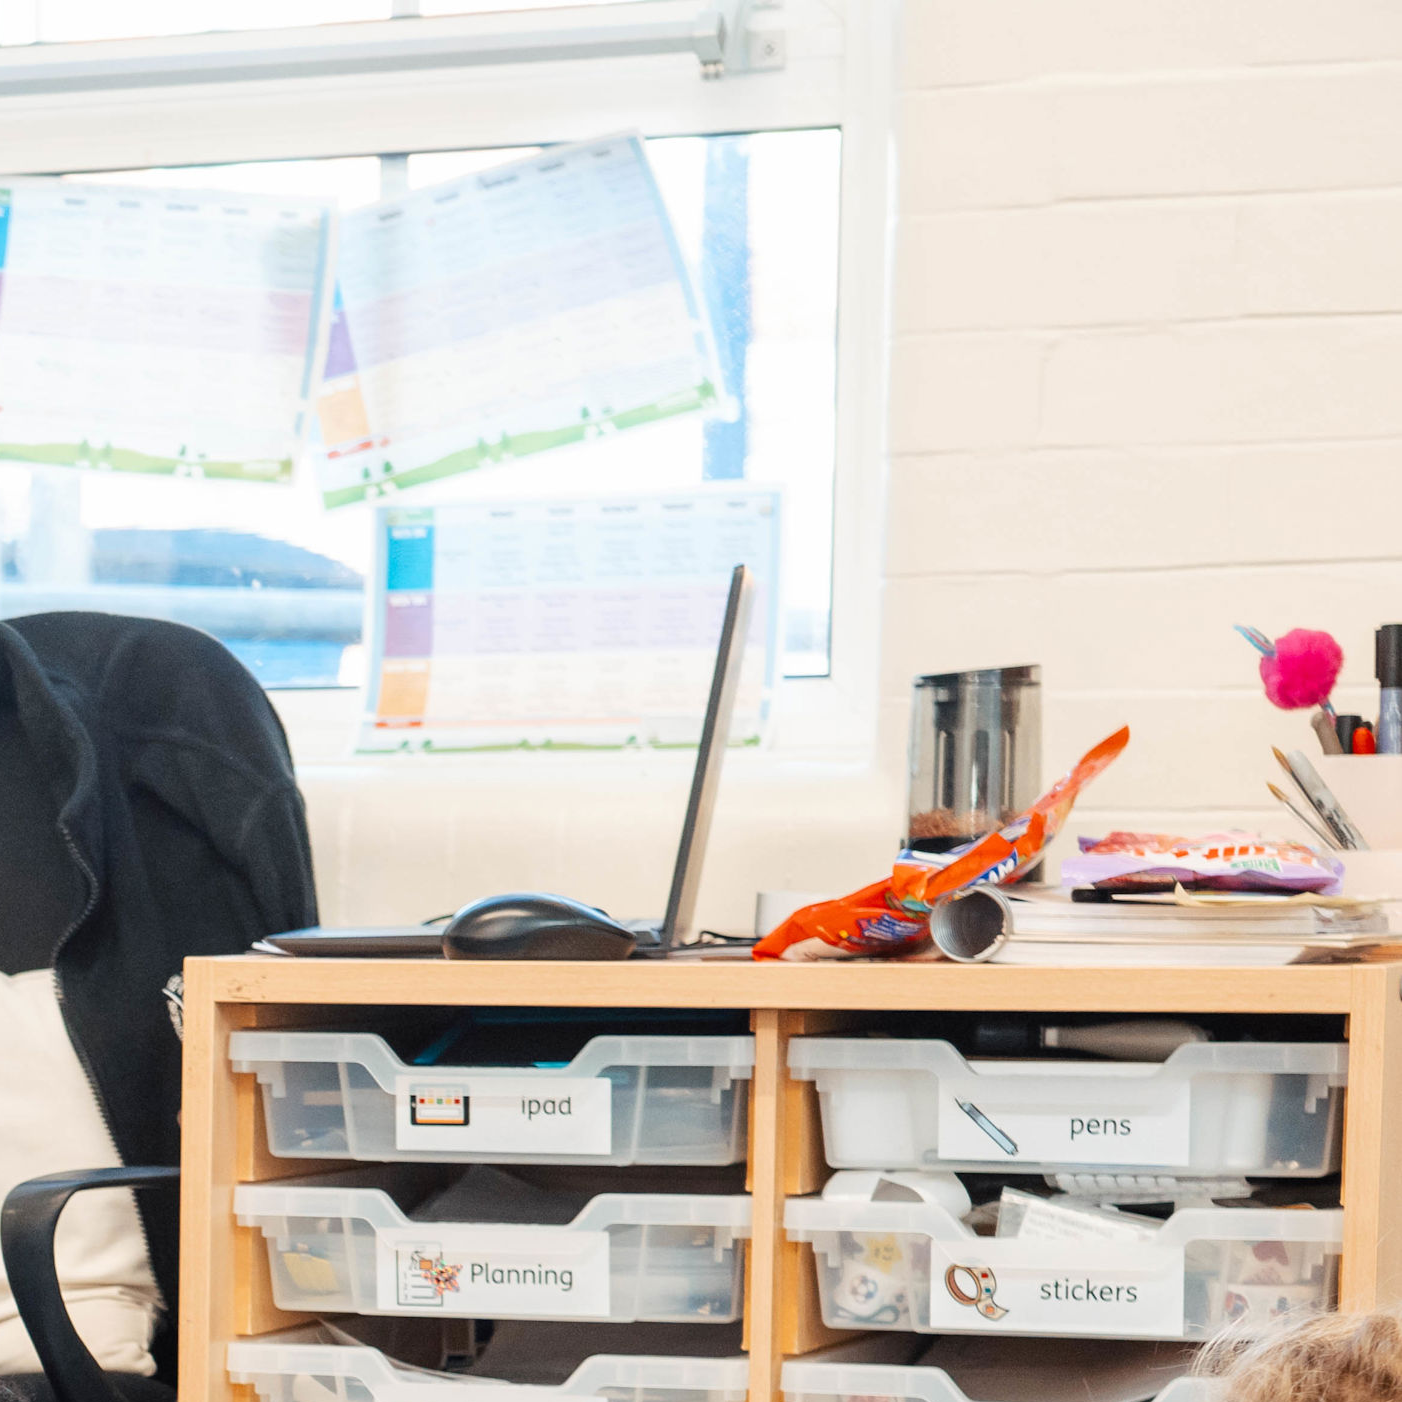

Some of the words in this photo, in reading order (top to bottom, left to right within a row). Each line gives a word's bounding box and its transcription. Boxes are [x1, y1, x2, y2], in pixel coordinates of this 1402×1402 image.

[520, 1095, 573, 1119] ipad
[1069, 1115, 1132, 1141] pens
[469, 1263, 574, 1291] Planning
[1040, 1278, 1138, 1303] stickers
